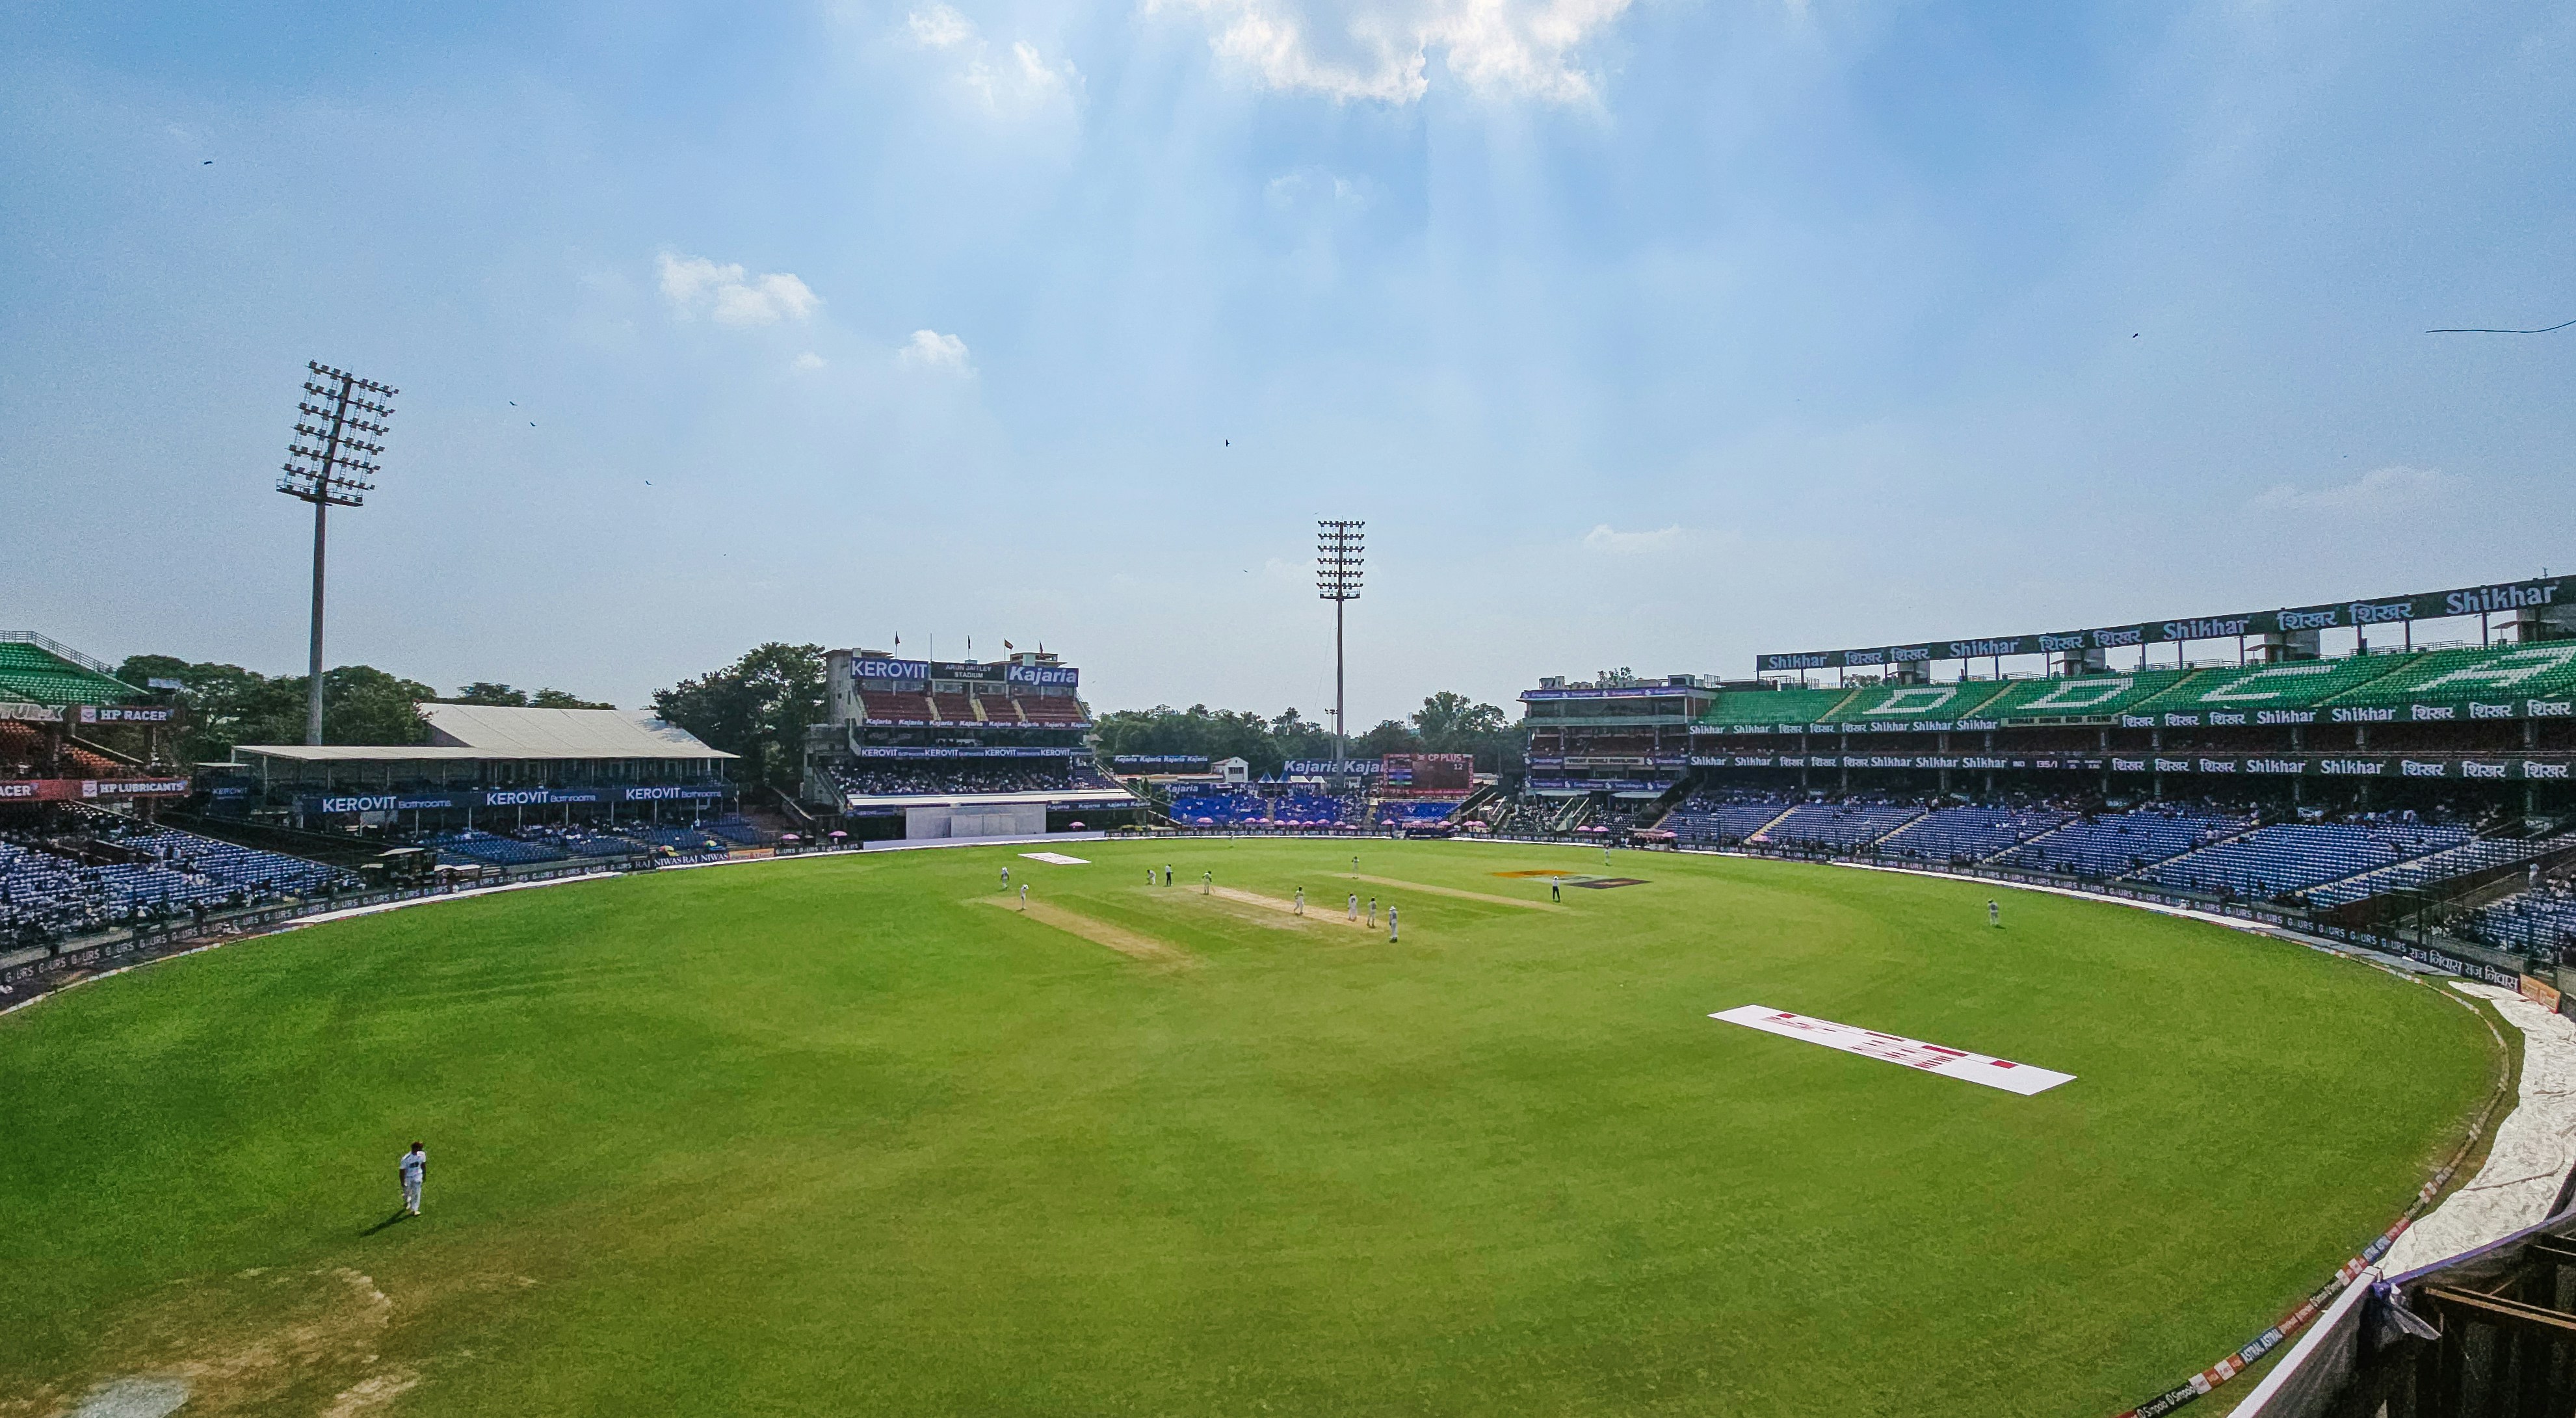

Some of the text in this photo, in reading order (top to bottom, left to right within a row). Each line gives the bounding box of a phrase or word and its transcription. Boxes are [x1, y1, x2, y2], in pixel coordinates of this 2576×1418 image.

[2446, 586, 2558, 614] Shikhar
[2277, 603, 2415, 631] शिखर शिखर
[2164, 620, 2249, 640] Shikhar
[1950, 640, 2019, 657] Shikhar
[2039, 631, 2143, 651] शिखर शिखर
[1768, 654, 1828, 669] Shikhar
[1845, 648, 1930, 665] शिखर शिखर
[852, 660, 928, 679] KEROVIT
[1010, 666, 1077, 685] Kajaria
[100, 709, 166, 721] HP RACER
[2257, 707, 2396, 724] Shikhar Shikhar
[2412, 700, 2571, 720] शिखर शिखर शिखर
[1871, 720, 1998, 731] Shikhar Shikhar Shikhar
[2122, 711, 2246, 727] शिखर शिखर शिखर
[1689, 724, 1770, 735] Shikhar Shikhar
[1284, 760, 1339, 775] Kajaria
[1690, 756, 1727, 766] Shikhar
[1735, 757, 1771, 767] Shikhar
[1871, 757, 2006, 768] Shikhar Shikhar Shikhar
[2112, 758, 2236, 772] शिखर शिखर शिखर
[2246, 759, 2384, 774] Shikhar Shikhar
[2401, 760, 2569, 778] शिखर शिखर शिखर
[100, 782, 184, 793] HP LUBRICANTS
[626, 787, 681, 800] KEROVIT
[322, 796, 397, 813] KEROVIT
[486, 791, 549, 806] KEROVIT
[654, 857, 682, 867] NIWAS
[683, 855, 698, 863] RAJ
[701, 853, 729, 862] NIWAS
[2409, 947, 2518, 990] राज निवास राज निवास
[2260, 1328, 2284, 1350] ASTRAL
[2240, 1341, 2265, 1365] ASTRAL
